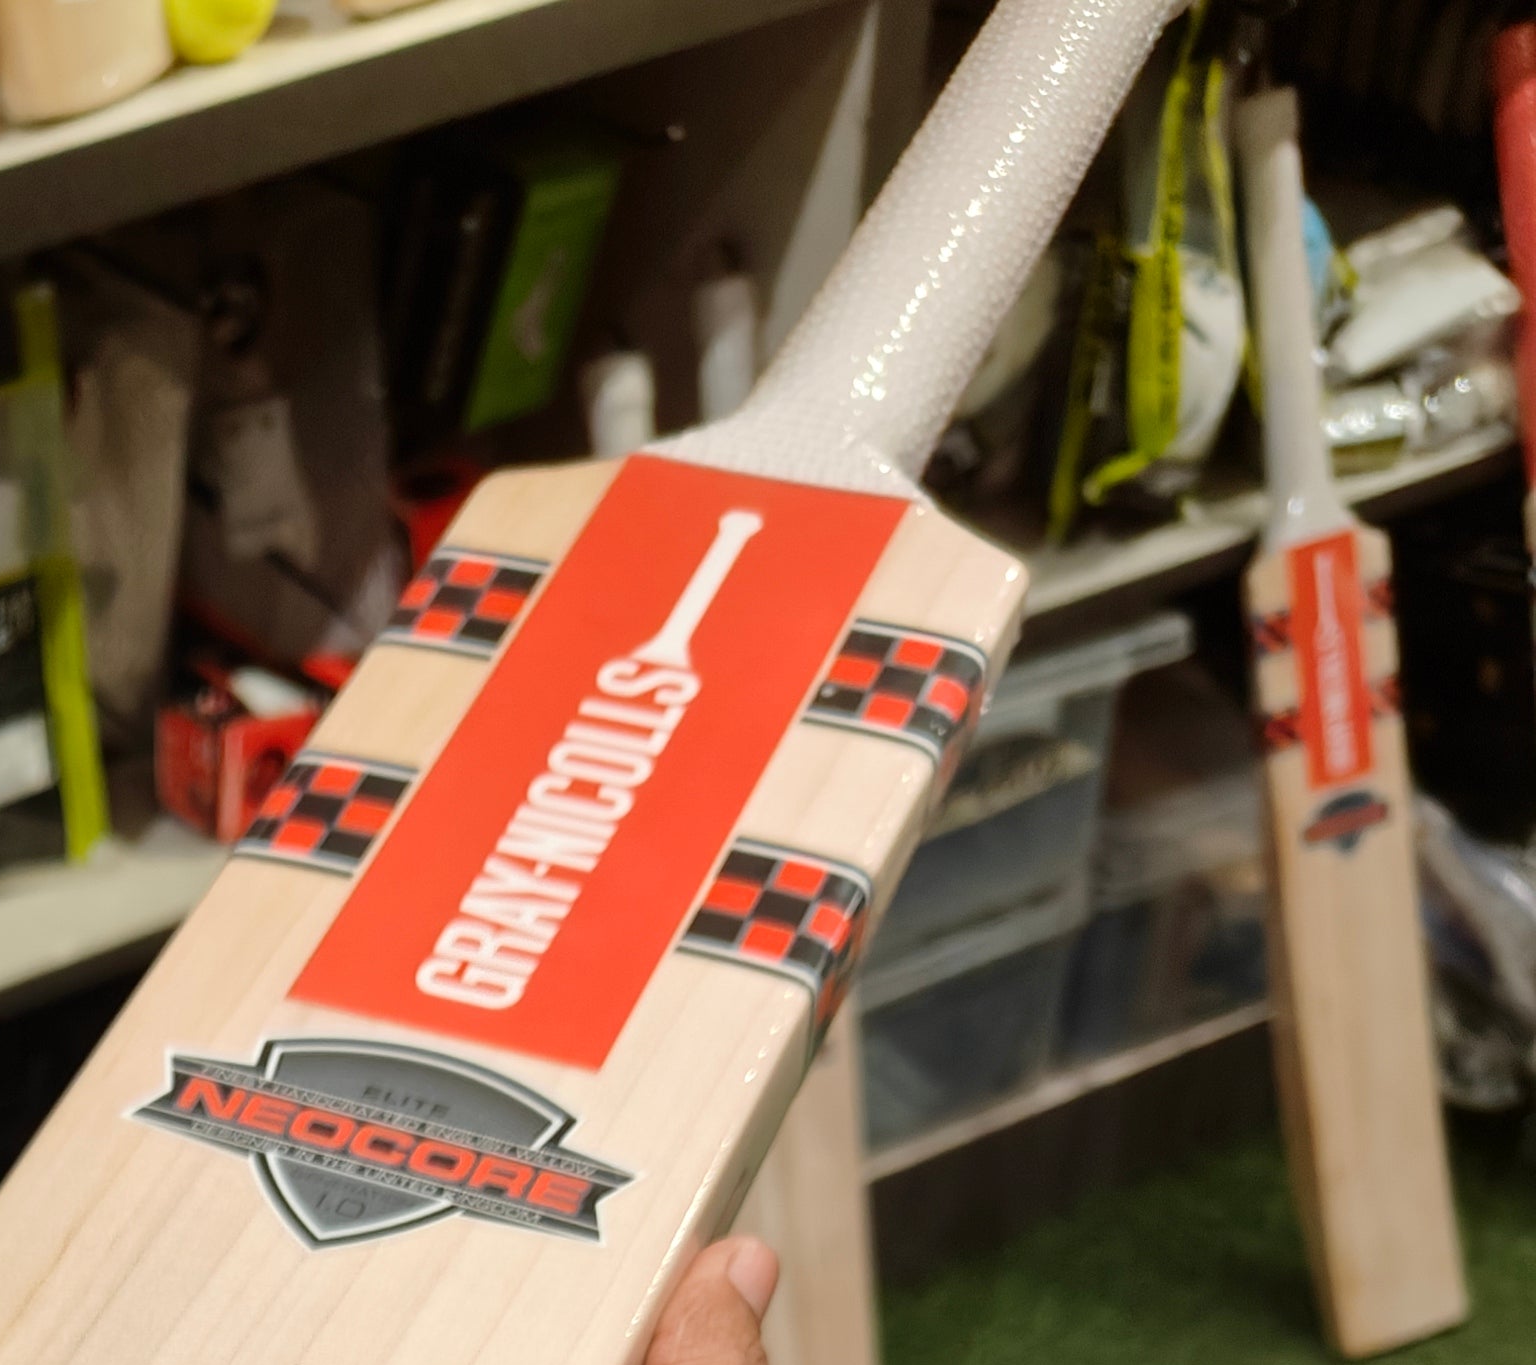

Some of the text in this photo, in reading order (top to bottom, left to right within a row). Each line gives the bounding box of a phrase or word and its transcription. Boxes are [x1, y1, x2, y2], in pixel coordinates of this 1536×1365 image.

[415, 656, 702, 1011] GRAY-NICOLLS
[176, 1075, 590, 1214] NEOCORE
[361, 1084, 450, 1119] ELITE
